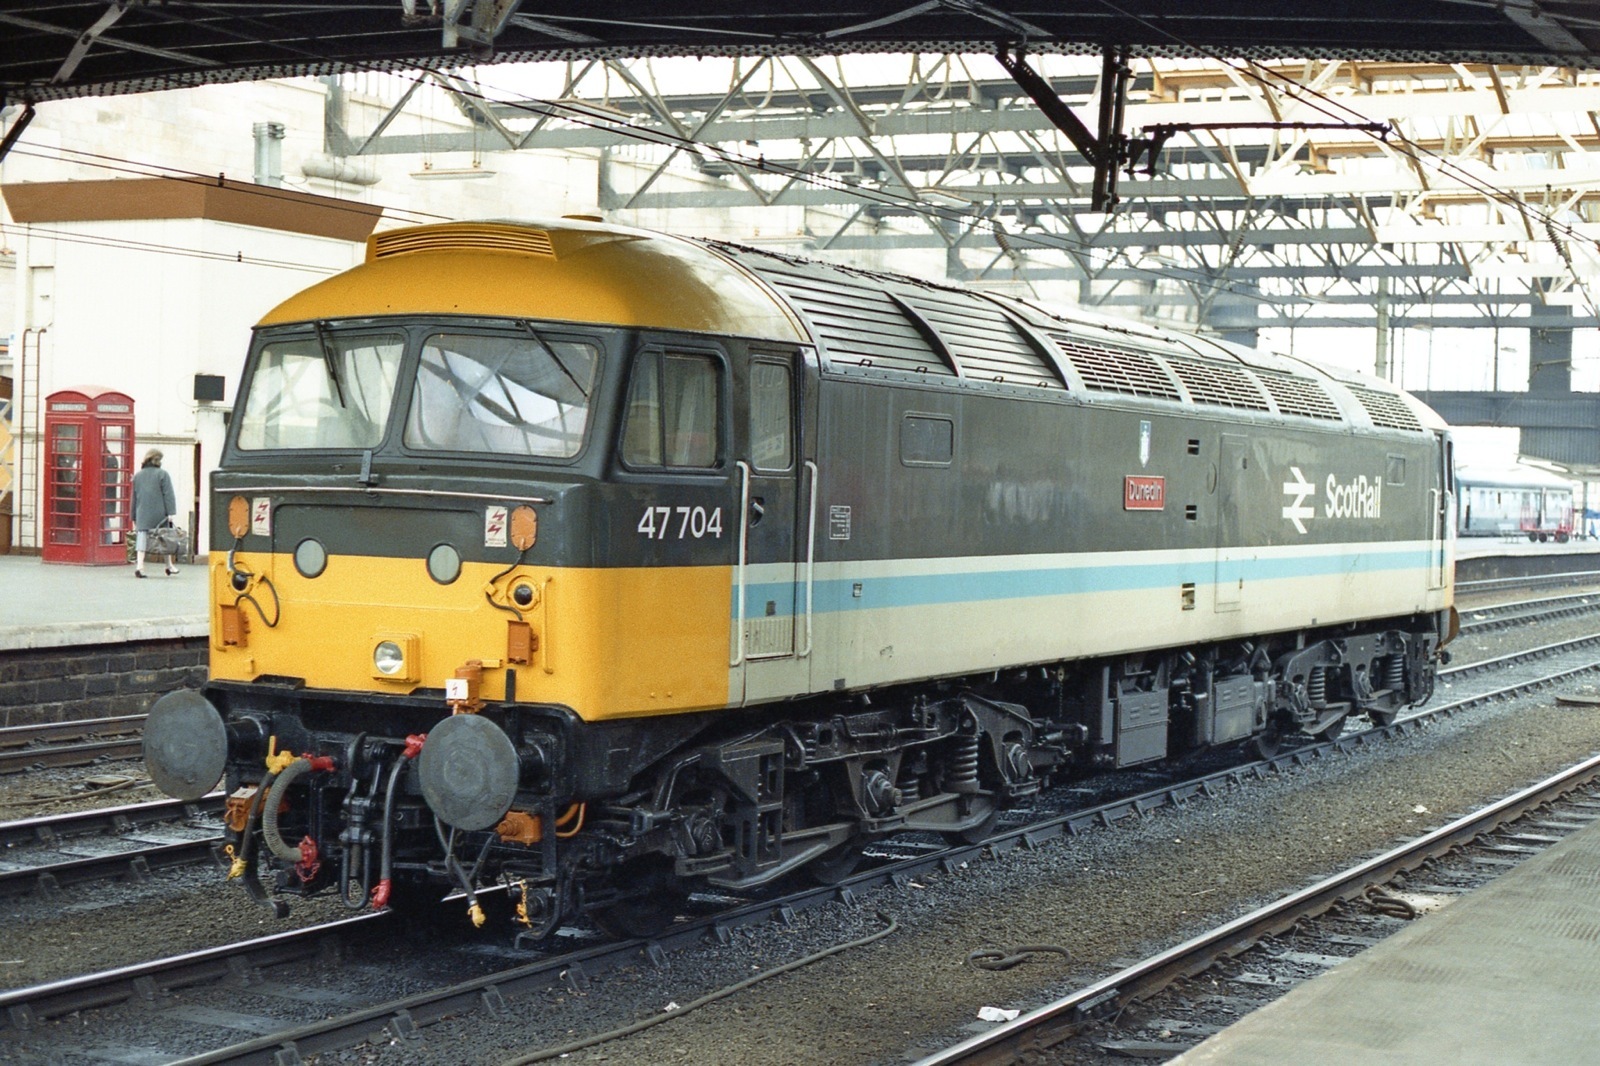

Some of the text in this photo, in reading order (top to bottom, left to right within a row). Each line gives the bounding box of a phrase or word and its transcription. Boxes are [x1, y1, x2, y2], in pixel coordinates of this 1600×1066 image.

[1129, 480, 1162, 501] Dunedin
[1325, 473, 1382, 519] ScotRail
[637, 505, 723, 540] 47 704
